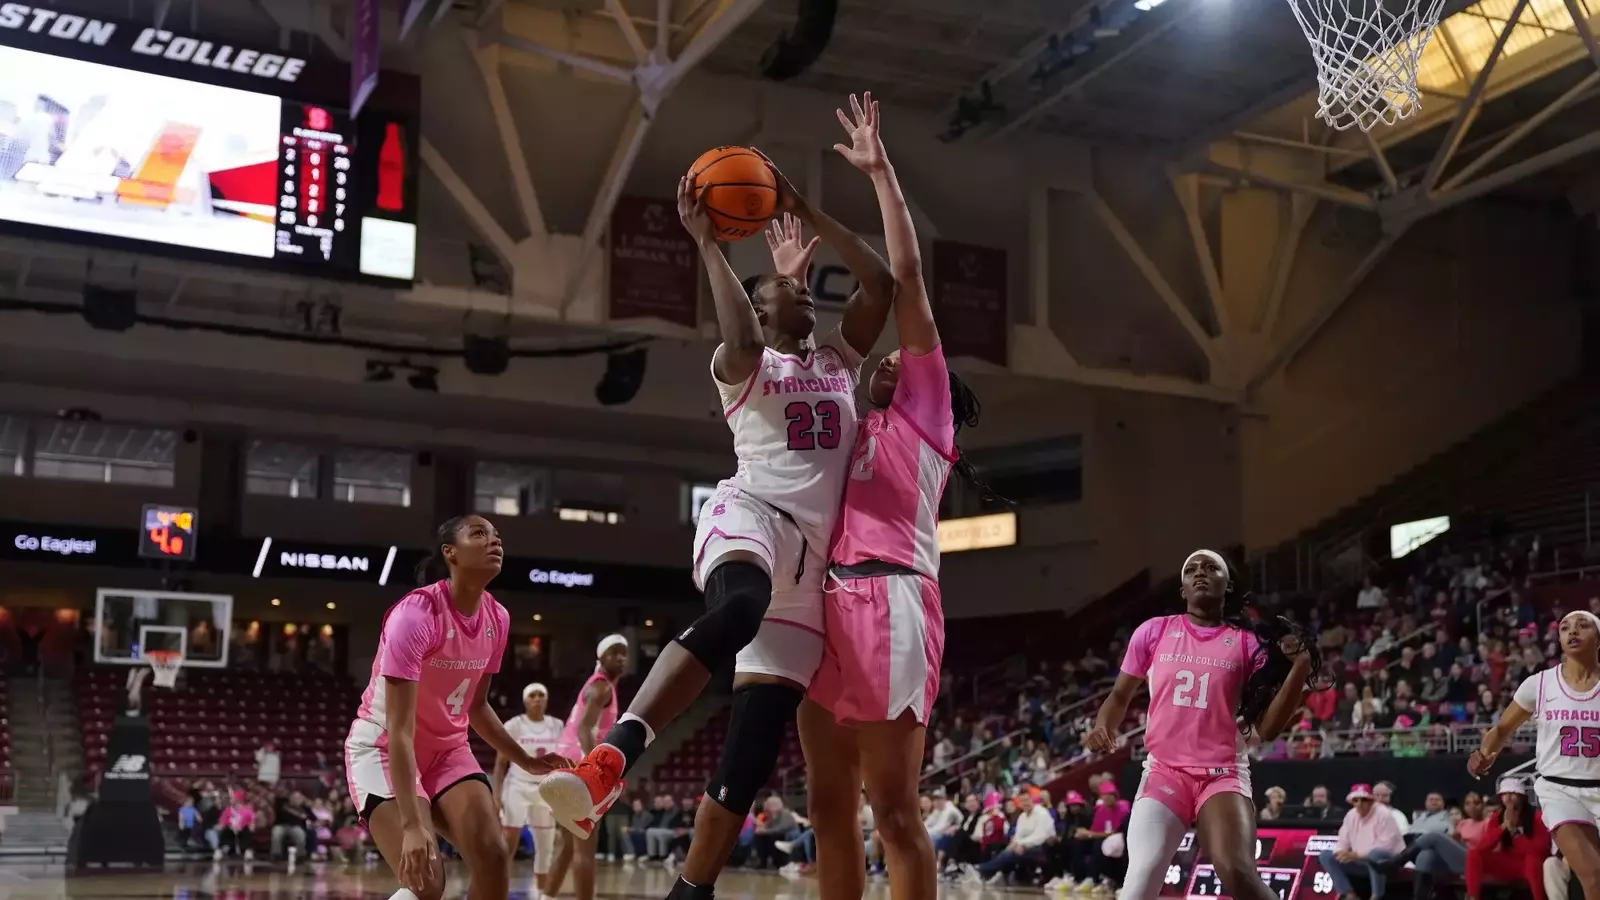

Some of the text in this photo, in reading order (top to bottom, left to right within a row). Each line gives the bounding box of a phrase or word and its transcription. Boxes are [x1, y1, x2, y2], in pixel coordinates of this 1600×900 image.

[131, 28, 306, 82] COLLEGE
[763, 375, 848, 397] SYRACUSE
[785, 400, 841, 450] 23
[15, 534, 97, 555] Go Eagles!
[280, 551, 369, 572] NISSAN
[529, 568, 549, 583] Go
[429, 657, 467, 670] BOSTON
[1160, 653, 1194, 664] BOSTON
[446, 678, 471, 715] 4
[1172, 669, 1211, 709] 21
[1545, 709, 1600, 721] SYRACU
[1559, 725, 1600, 758] 25
